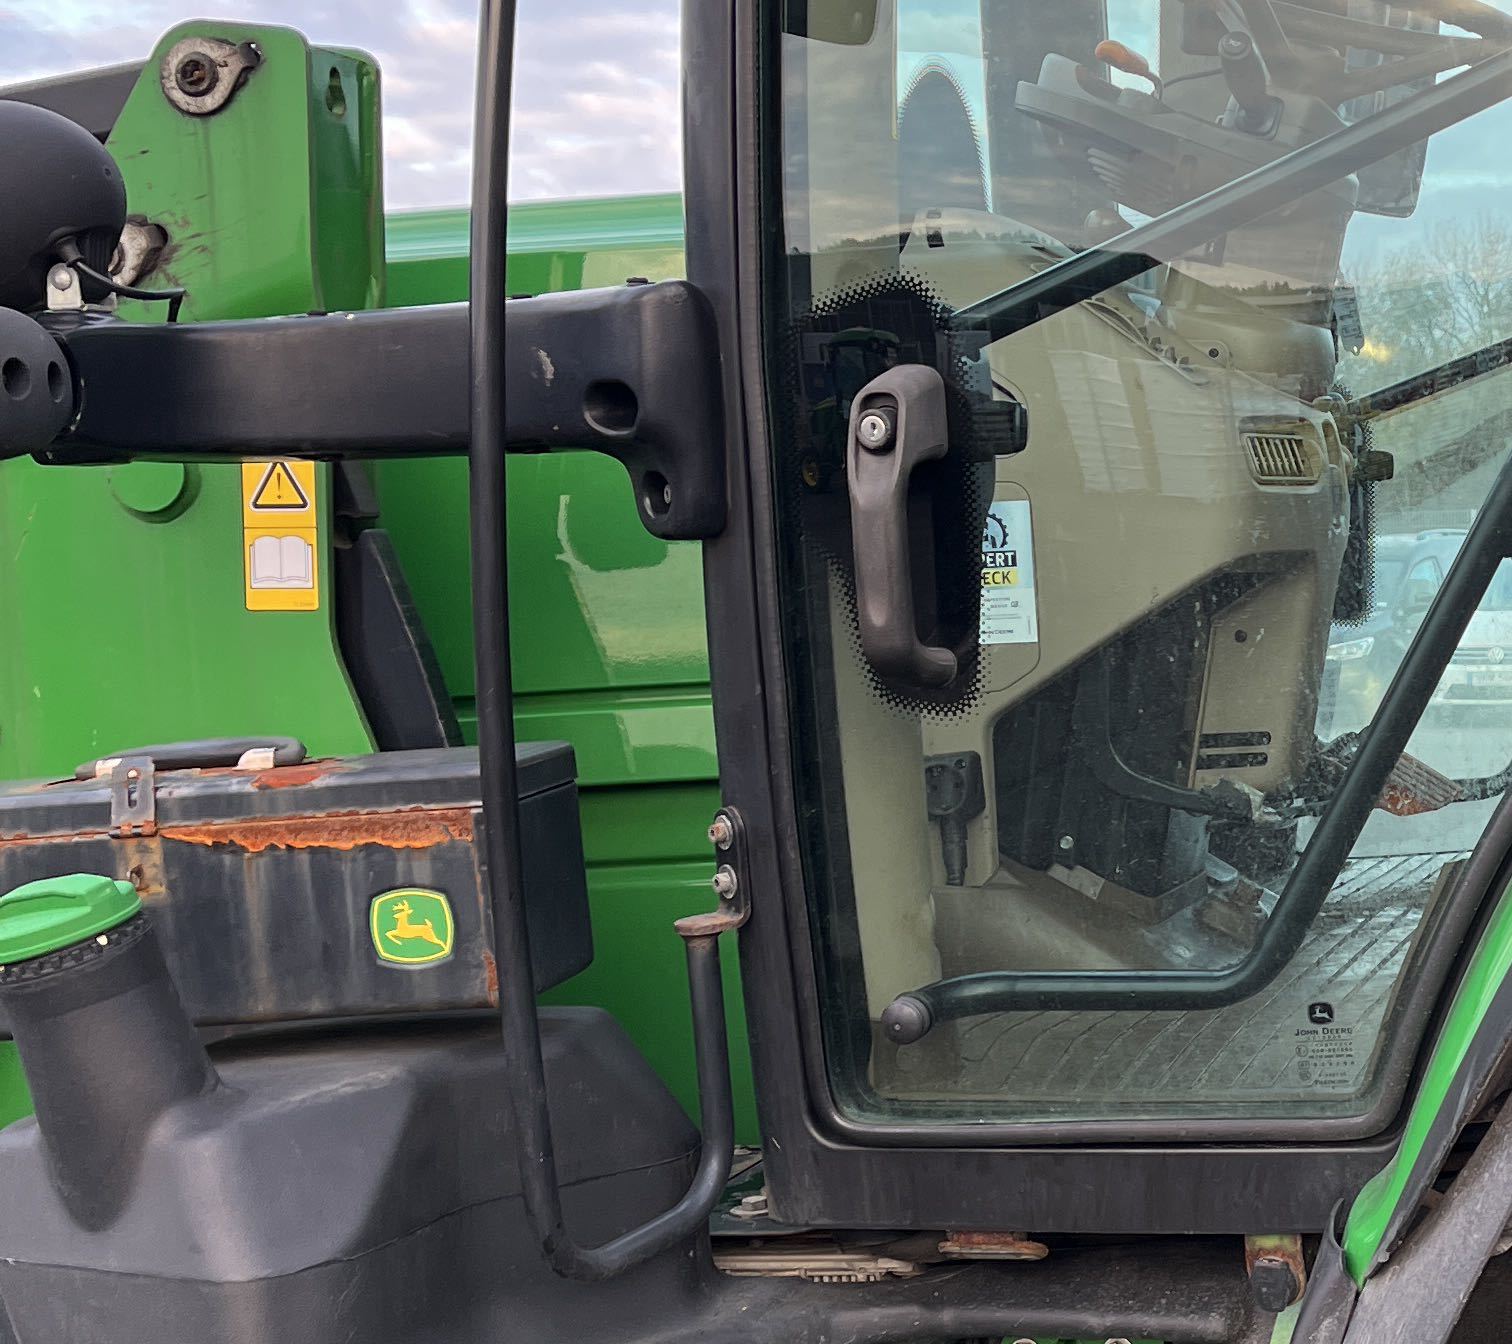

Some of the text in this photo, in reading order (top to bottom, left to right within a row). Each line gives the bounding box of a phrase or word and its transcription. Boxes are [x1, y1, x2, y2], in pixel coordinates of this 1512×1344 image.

[981, 571, 1012, 585] ECK
[1294, 1027, 1353, 1036] JOHN DEERE
